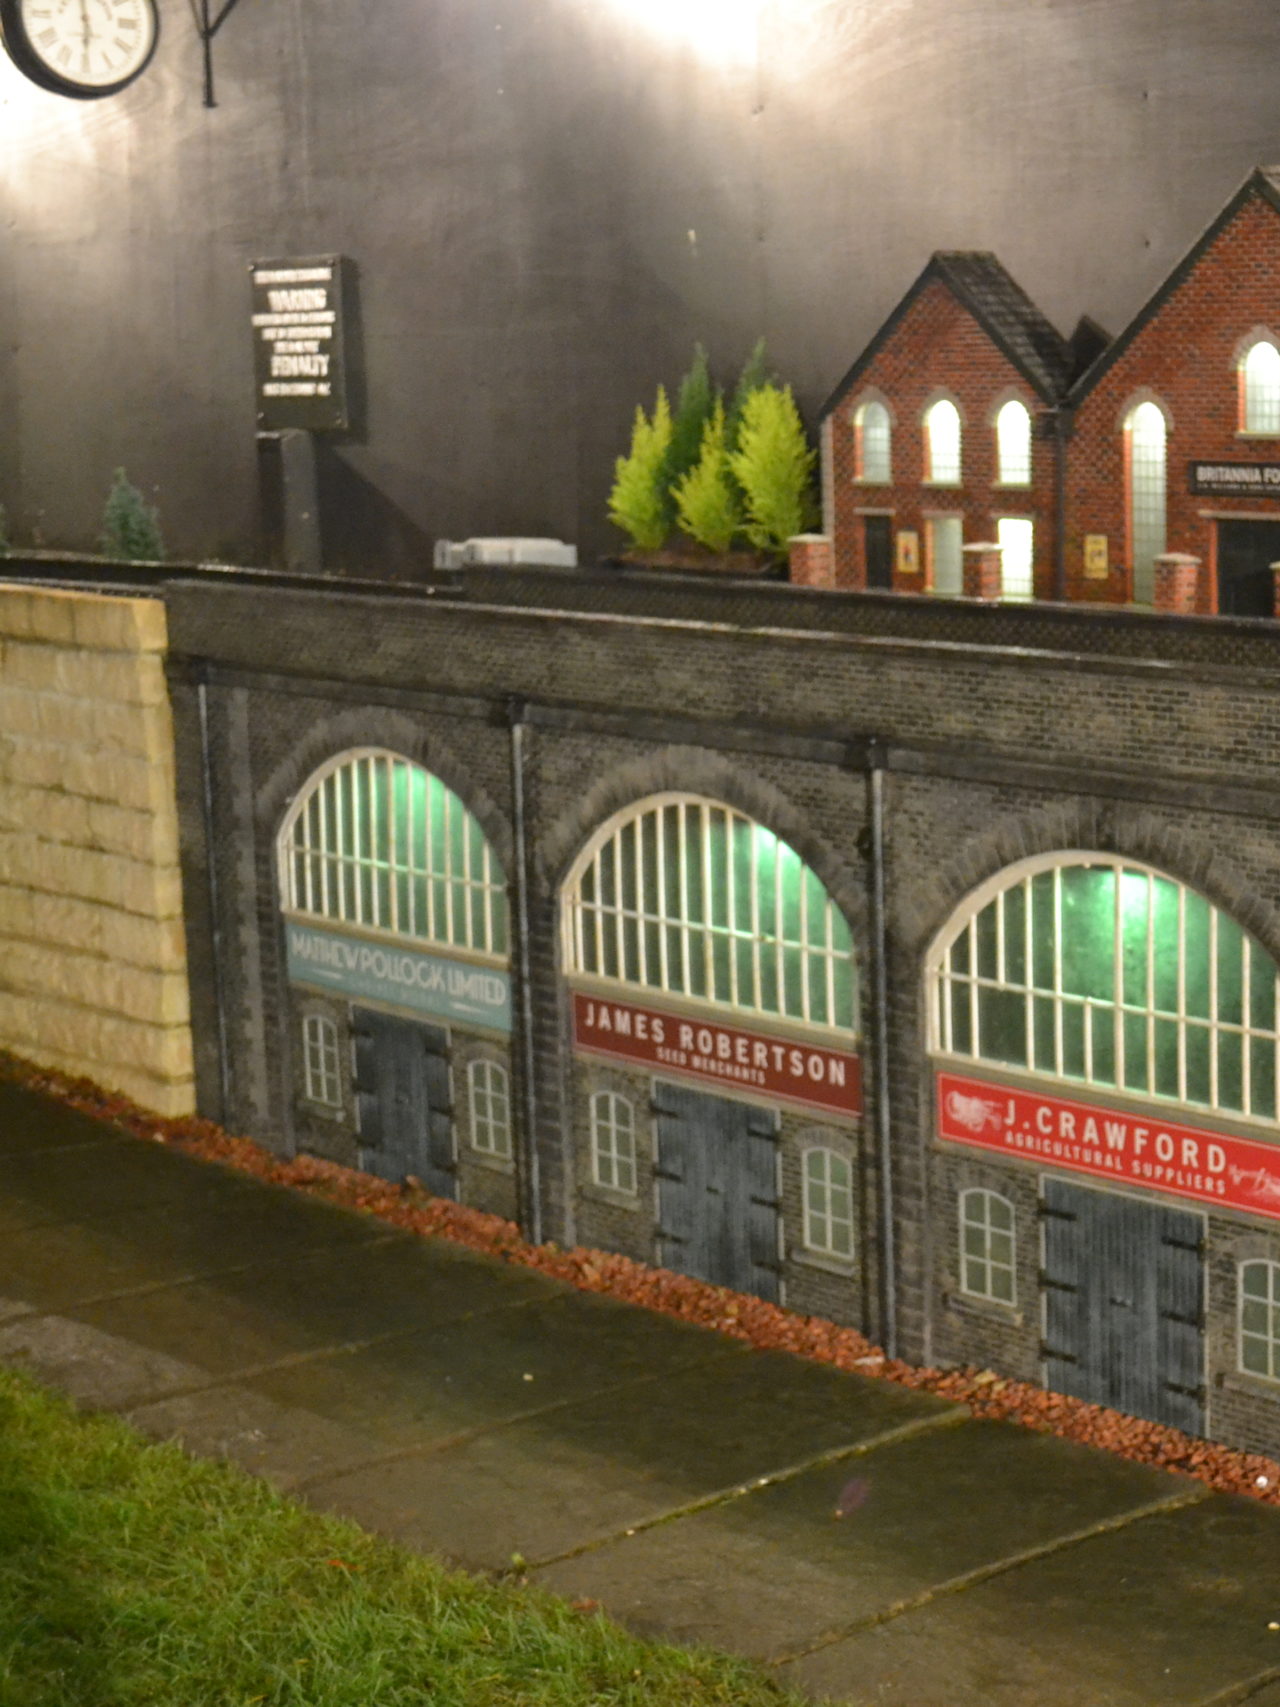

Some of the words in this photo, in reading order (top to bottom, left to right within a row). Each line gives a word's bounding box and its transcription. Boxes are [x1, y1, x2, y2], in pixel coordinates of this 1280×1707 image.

[270, 354, 330, 377] PENALTY
[1196, 465, 1262, 483] BRITANNIA
[360, 946, 446, 994] POLLOCK
[446, 965, 507, 1006] LIMITED
[584, 1002, 665, 1044] JAMES
[678, 1023, 847, 1088] ROBERTSON
[656, 1045, 688, 1067] SEED
[691, 1053, 767, 1086] MERCHANTS
[1004, 1129, 1124, 1172] AGRICULTURAL
[1131, 1158, 1227, 1196] SUPPLIERS
